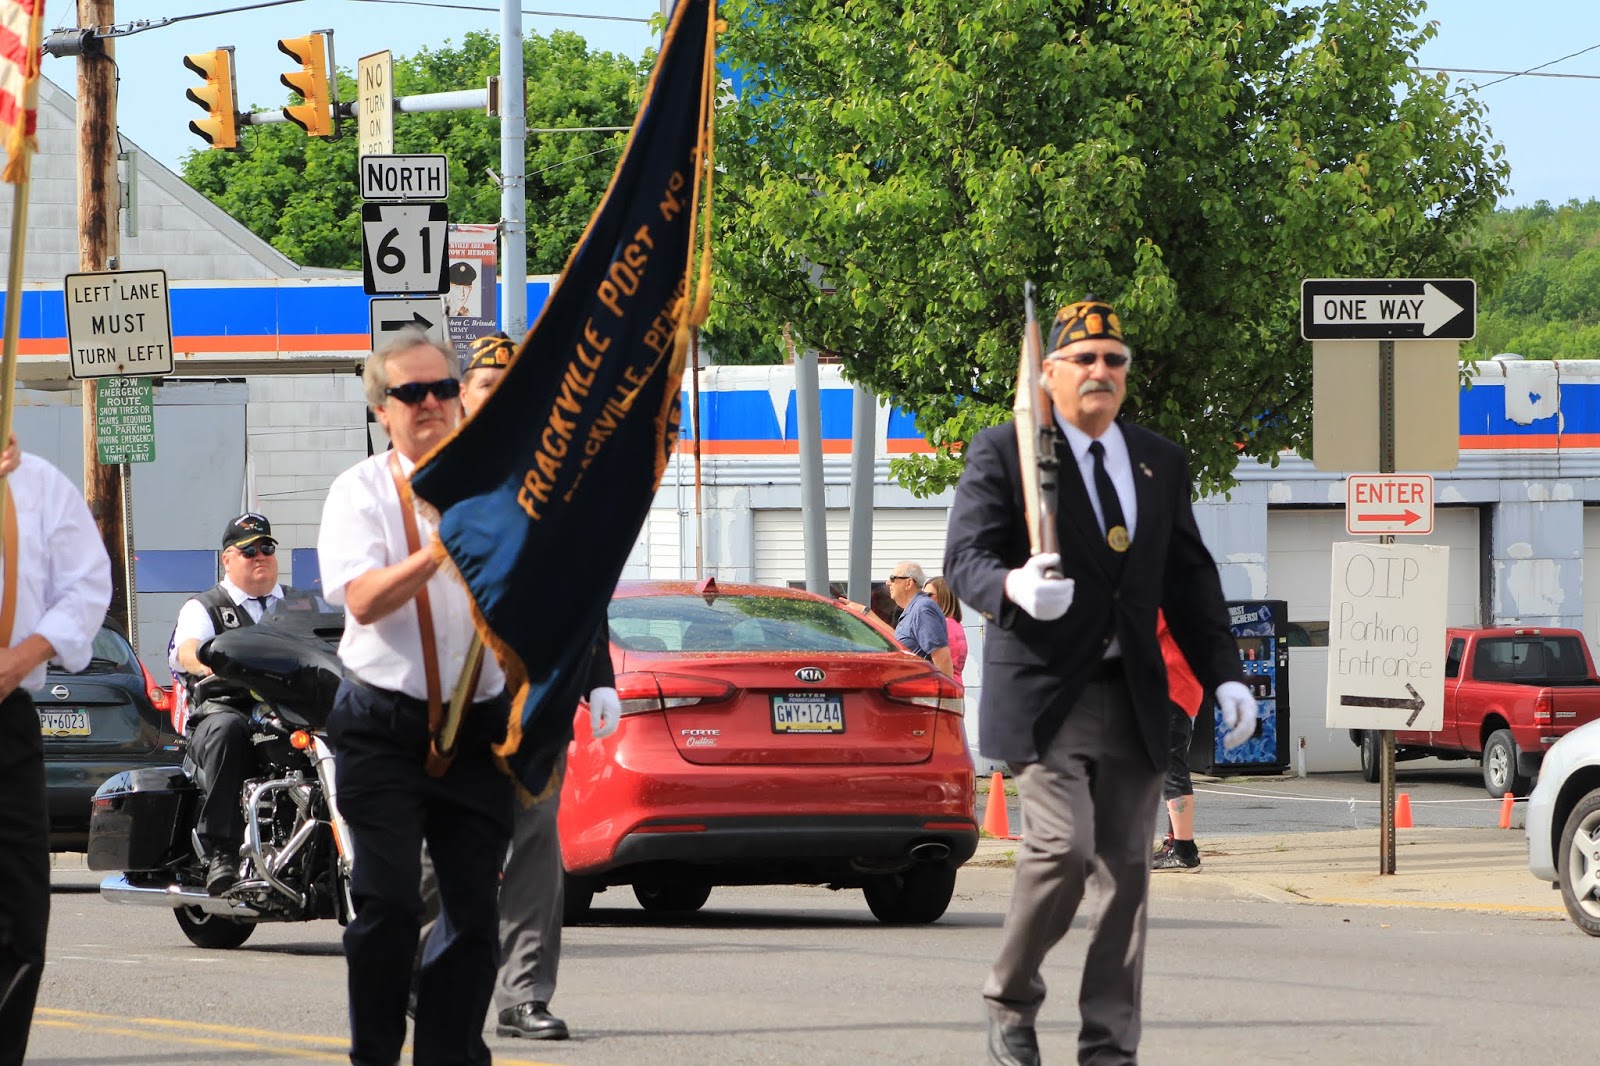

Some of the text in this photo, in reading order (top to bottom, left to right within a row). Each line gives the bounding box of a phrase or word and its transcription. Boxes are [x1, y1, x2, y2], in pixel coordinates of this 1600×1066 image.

[366, 64, 382, 91] NO
[366, 94, 384, 115] TURN
[370, 118, 380, 137] ON
[368, 164, 440, 192] NORTH
[376, 226, 431, 274] 61
[75, 284, 159, 303] LEFT LANE
[1324, 300, 1424, 320] ONE WAY
[92, 313, 145, 334] MUST
[78, 344, 164, 364] TURN LEFT
[517, 316, 611, 520] FRACKVILLE
[597, 224, 654, 318] POST
[100, 387, 149, 397] EMERGENCY
[109, 378, 138, 387] SNOW
[100, 406, 150, 416] SNOW TIRES OR
[107, 397, 141, 406] ROUTE
[98, 415, 152, 425] CHAINS REQUIRED
[98, 434, 154, 444] DURING EMERGENCY
[100, 425, 151, 435] NO PARKING
[104, 444, 149, 454] VEHICLES
[132, 453, 149, 462] AWAY
[1356, 483, 1424, 504] ENTER
[1340, 602, 1418, 657] Parking
[1338, 648, 1432, 678] Entrance
[800, 670, 822, 680] KIA
